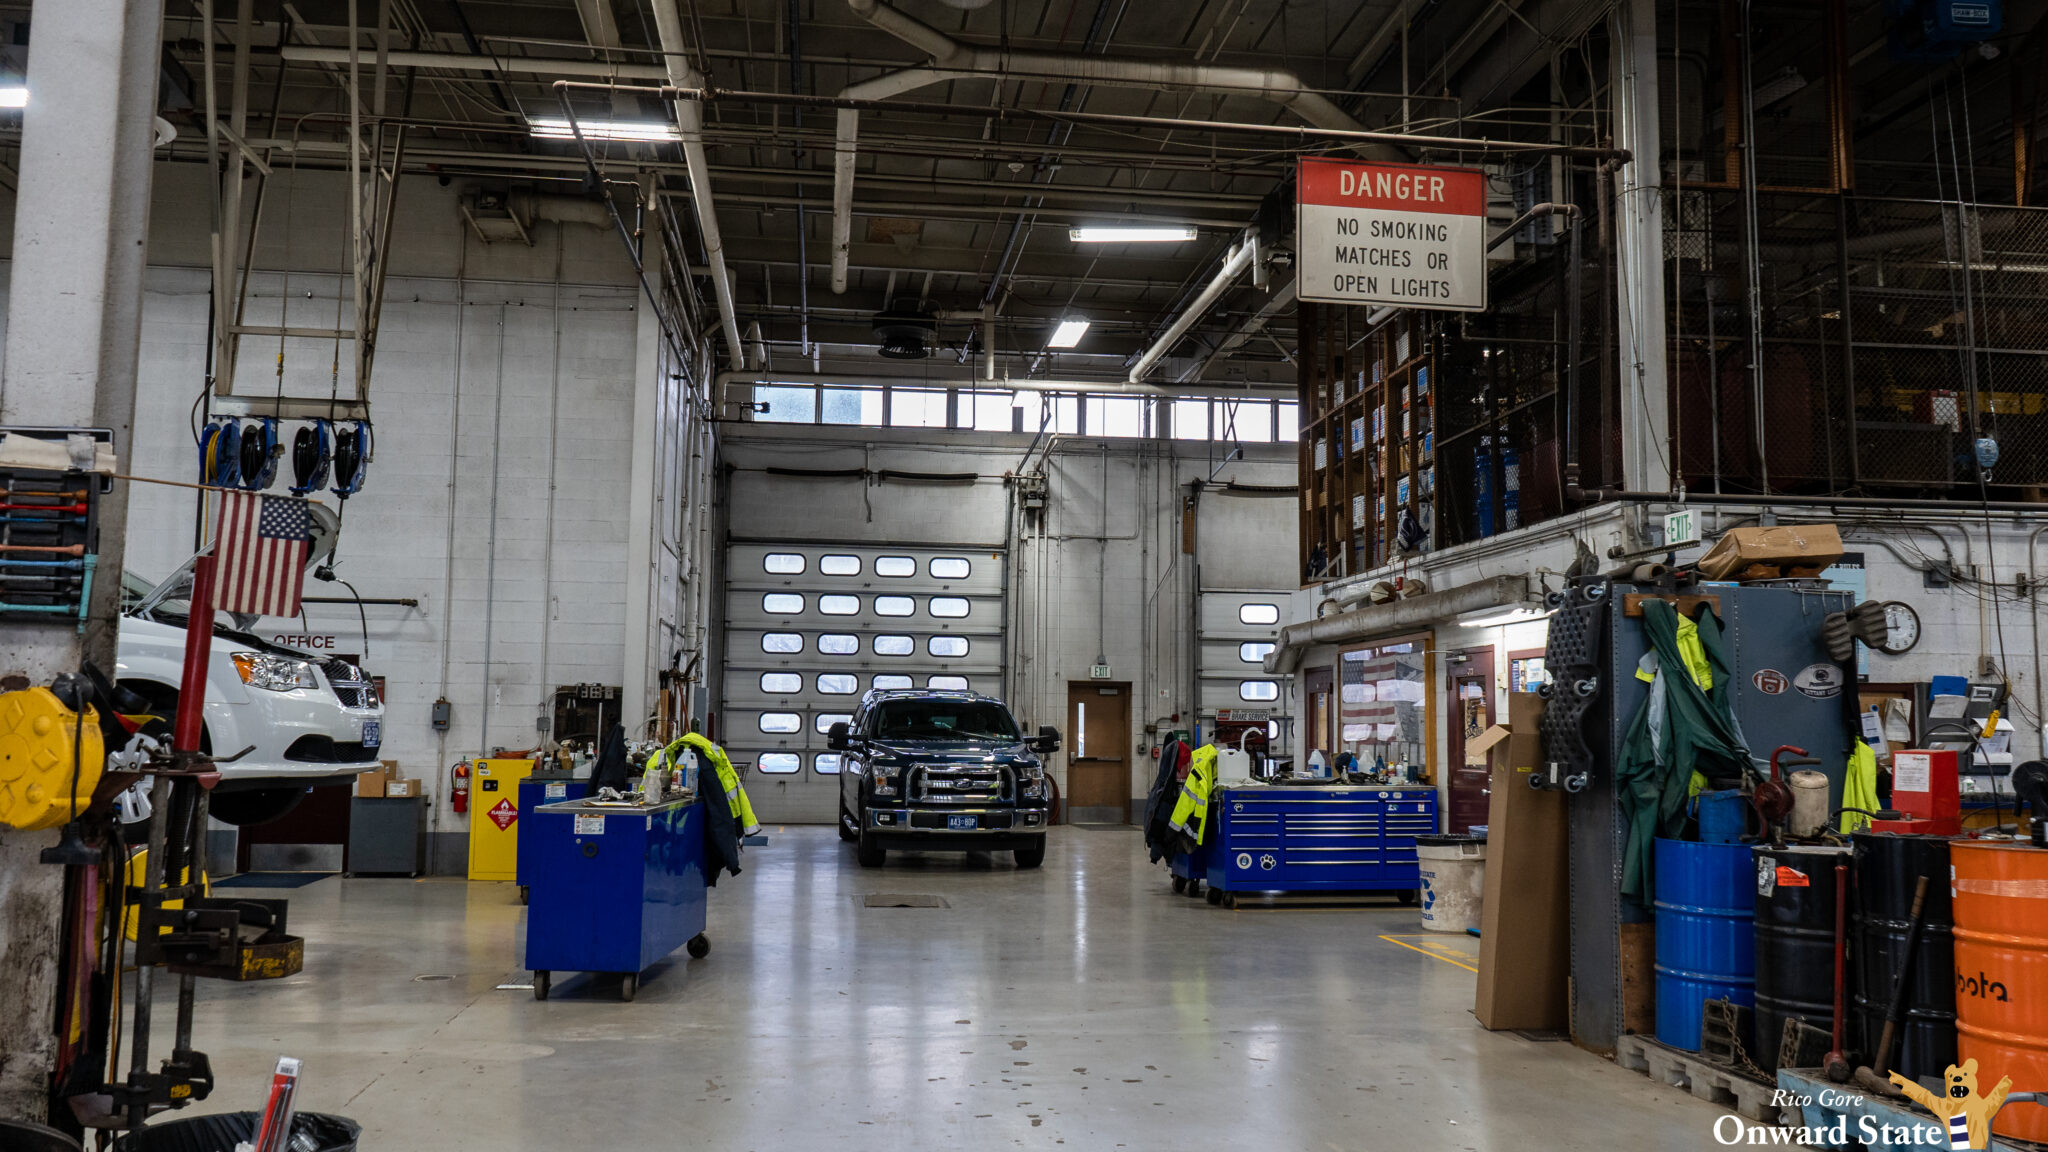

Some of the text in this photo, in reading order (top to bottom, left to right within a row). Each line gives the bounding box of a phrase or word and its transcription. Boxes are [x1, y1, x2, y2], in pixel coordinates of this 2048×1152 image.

[1340, 170, 1445, 202] DANGER
[1337, 217, 1447, 242] NO SMOKING
[1335, 245, 1448, 270] MATCHES OR
[1334, 274, 1450, 298] OPEN LIGHTS
[1670, 514, 1688, 542] EXIT
[273, 634, 336, 649] OFFICE
[1094, 666, 1109, 677] EXIT
[1248, 712, 1268, 720] SERVICE
[1956, 967, 2009, 1002] bota
